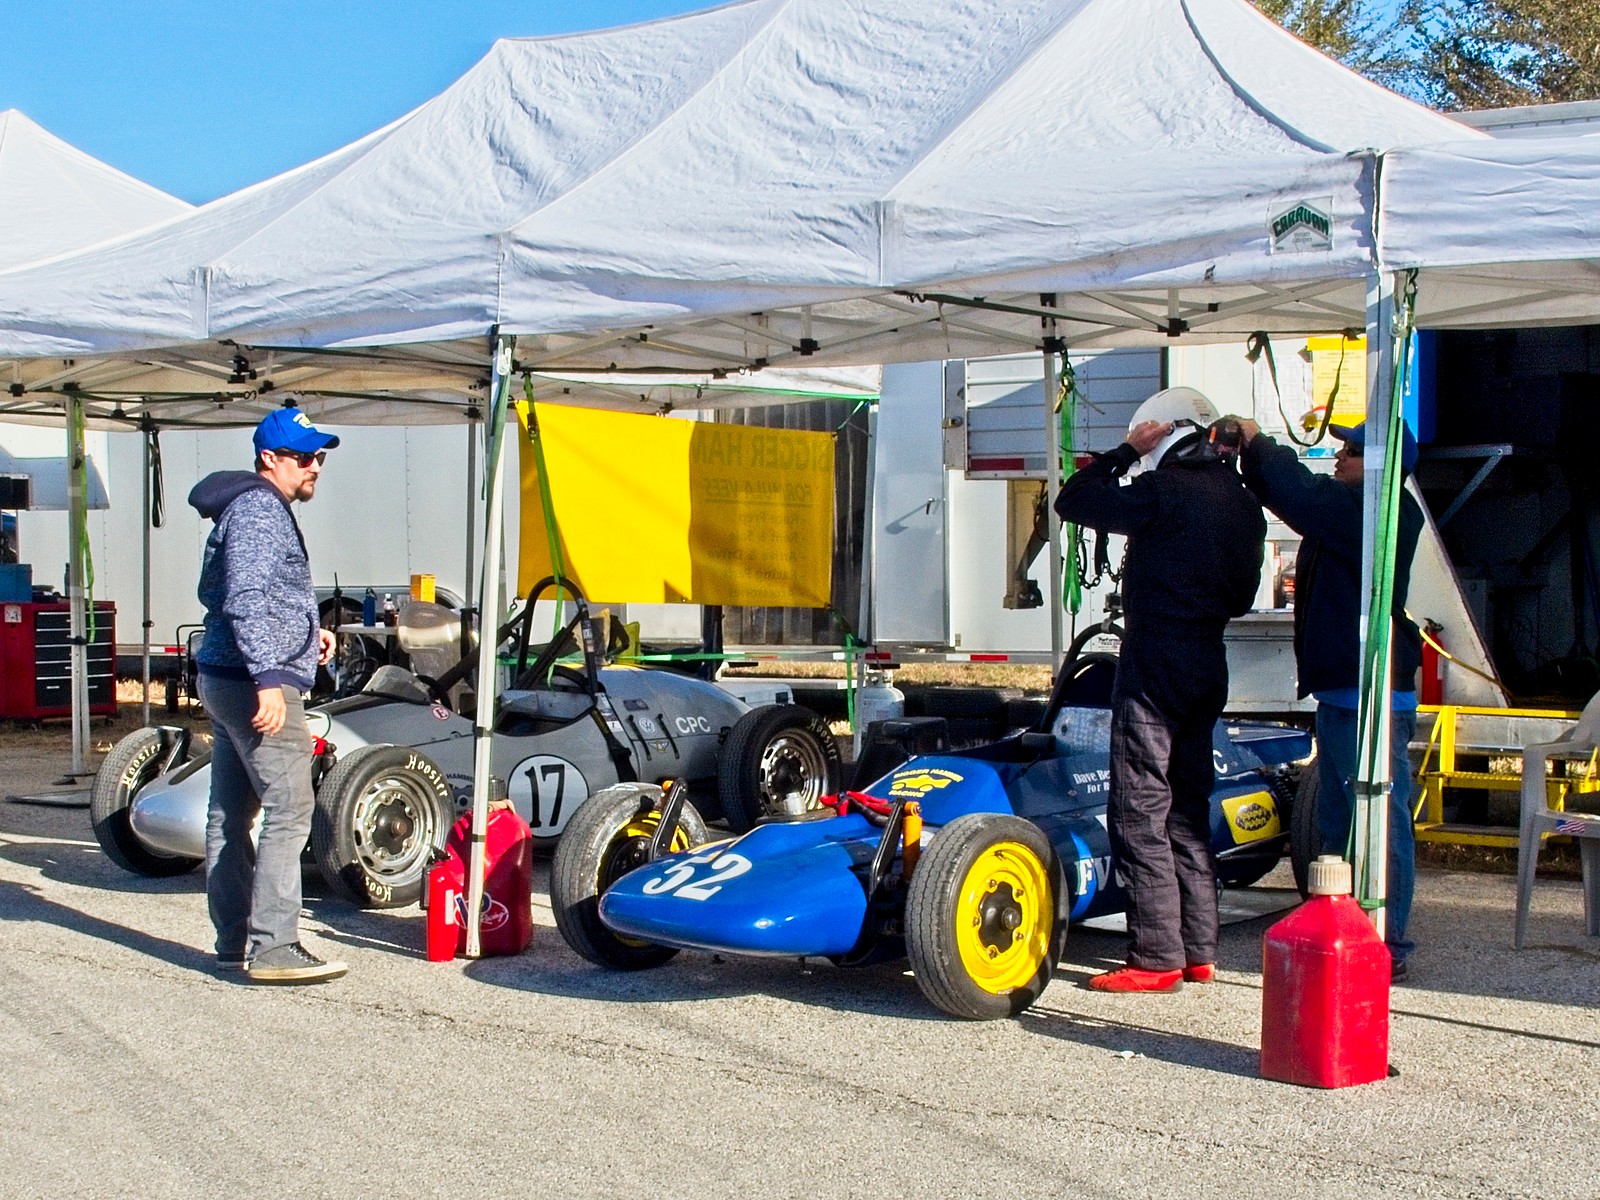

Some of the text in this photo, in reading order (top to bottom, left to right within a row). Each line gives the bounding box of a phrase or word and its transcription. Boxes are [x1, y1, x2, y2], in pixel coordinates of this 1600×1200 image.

[675, 716, 711, 734] CPC
[405, 754, 448, 798] Hoosier
[524, 763, 565, 828] 17
[1073, 770, 1110, 784] Dave Be
[642, 853, 753, 901] 52
